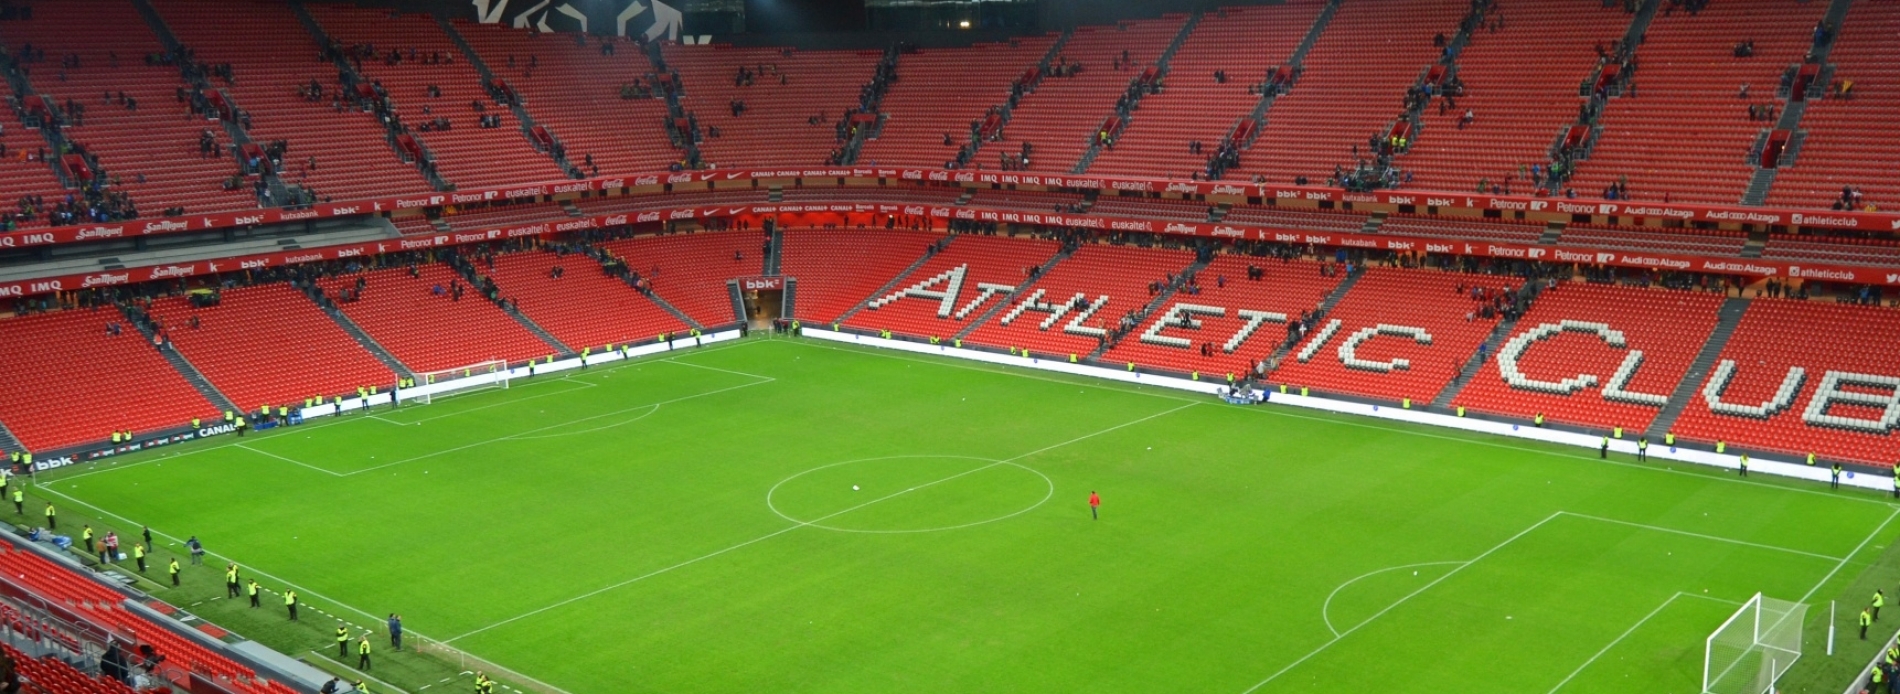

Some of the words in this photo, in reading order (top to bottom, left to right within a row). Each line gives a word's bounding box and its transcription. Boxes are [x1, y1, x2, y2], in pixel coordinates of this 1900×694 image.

[981, 175, 997, 183] IMQ
[1045, 178, 1062, 186] IMQ
[1067, 178, 1098, 188] euskaltel
[1112, 179, 1146, 190] euskaltel
[505, 186, 540, 198] euskaltel
[554, 181, 587, 192] euskaltel
[396, 197, 428, 207] Petronor
[452, 194, 482, 202] Petronor
[1343, 194, 1377, 202] kutxabank
[1490, 198, 1528, 209] Petronor
[1557, 201, 1595, 213] Petronor
[1624, 206, 1646, 215] Audi
[1663, 209, 1694, 218] Alzaga
[280, 208, 318, 220] kutxabank
[982, 212, 997, 220] IMQ
[1003, 214, 1019, 222] IMQ
[1024, 215, 1040, 223] IMQ
[1706, 210, 1728, 219] Audi
[1748, 213, 1779, 223] Alzaga
[557, 219, 590, 231] euskaltel
[1046, 216, 1062, 225] IMQ
[1066, 218, 1098, 227] euskaltel
[1112, 221, 1145, 230] euskaltel
[1804, 216, 1857, 226] athleticclub
[508, 225, 543, 236] euskaltel
[24, 233, 54, 244] IMQ
[400, 235, 431, 248] Petronor
[456, 233, 485, 242] Petronor
[1342, 238, 1377, 247] kutxabank
[1489, 245, 1525, 257] Petronor
[1555, 250, 1593, 262] Petronor
[286, 253, 323, 263] kutxabank
[1622, 256, 1642, 264] Audi
[1660, 259, 1690, 269] Alzaga
[1704, 261, 1726, 269] Audi
[1744, 264, 1776, 275] Alzaga
[1801, 268, 1855, 280] athleticclub
[31, 281, 62, 292] IMQ
